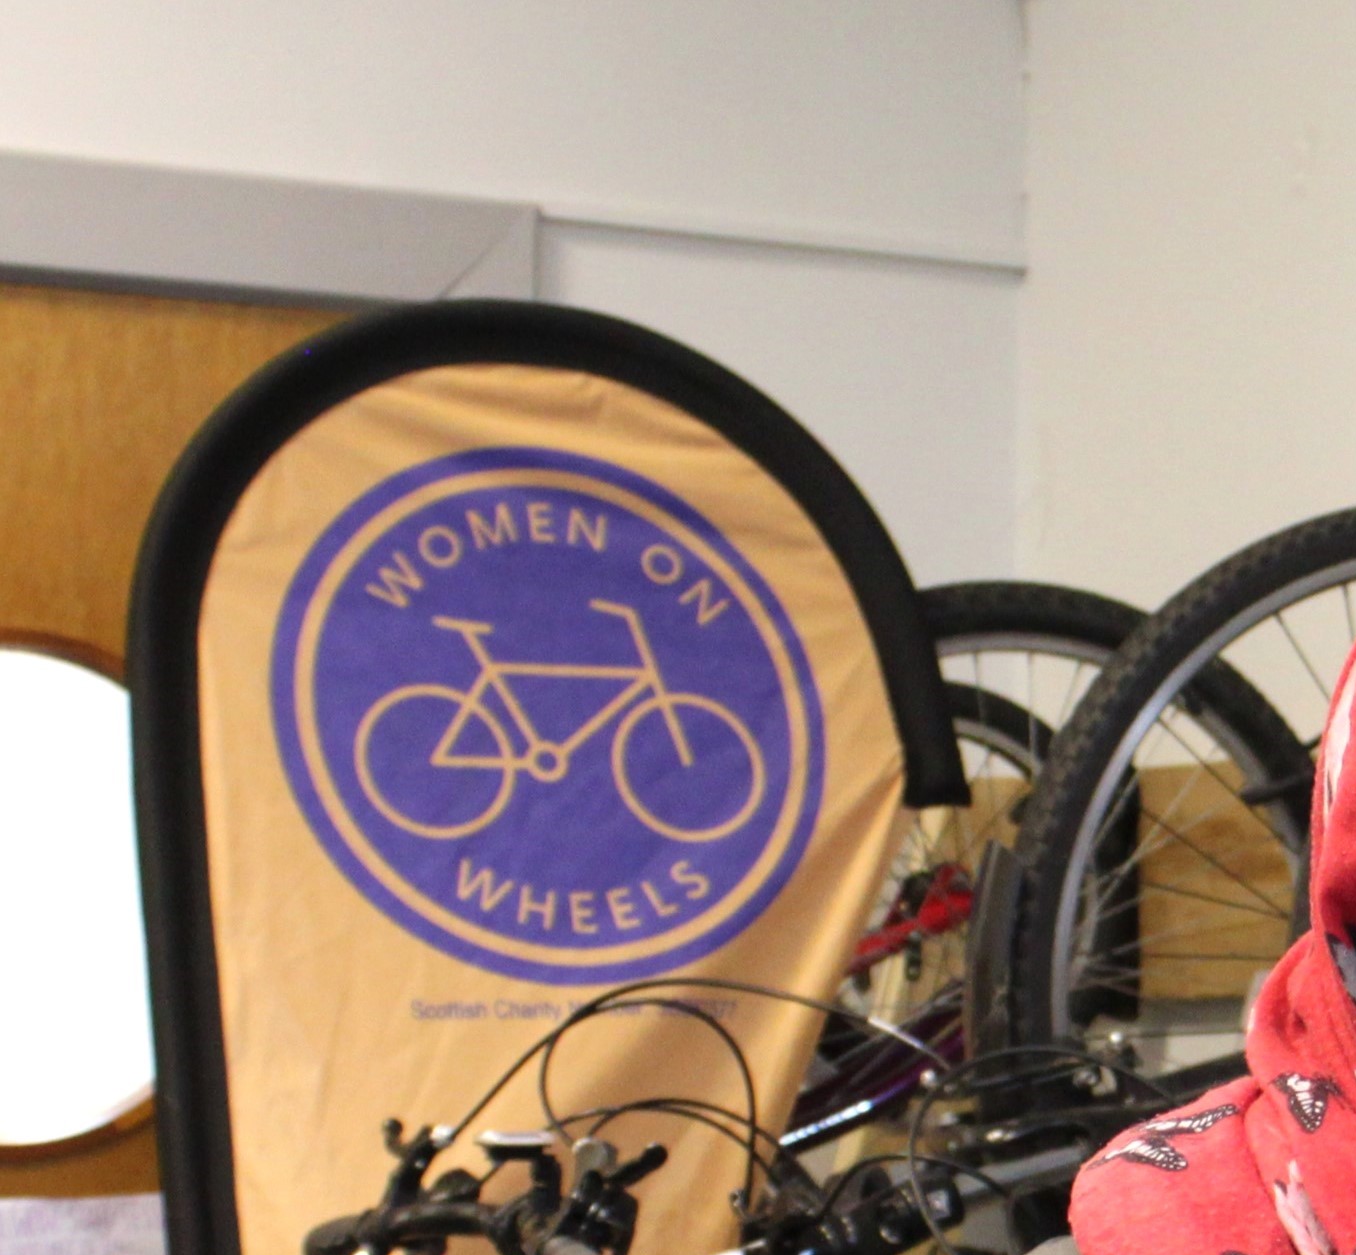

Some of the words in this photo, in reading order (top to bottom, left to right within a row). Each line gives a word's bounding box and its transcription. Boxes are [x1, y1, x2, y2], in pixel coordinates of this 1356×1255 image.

[366, 504, 608, 608] WOMEN
[641, 545, 730, 625] ON
[456, 858, 710, 934] WHEELS
[411, 999, 487, 1020] Scottish
[494, 999, 561, 1021] Charity
